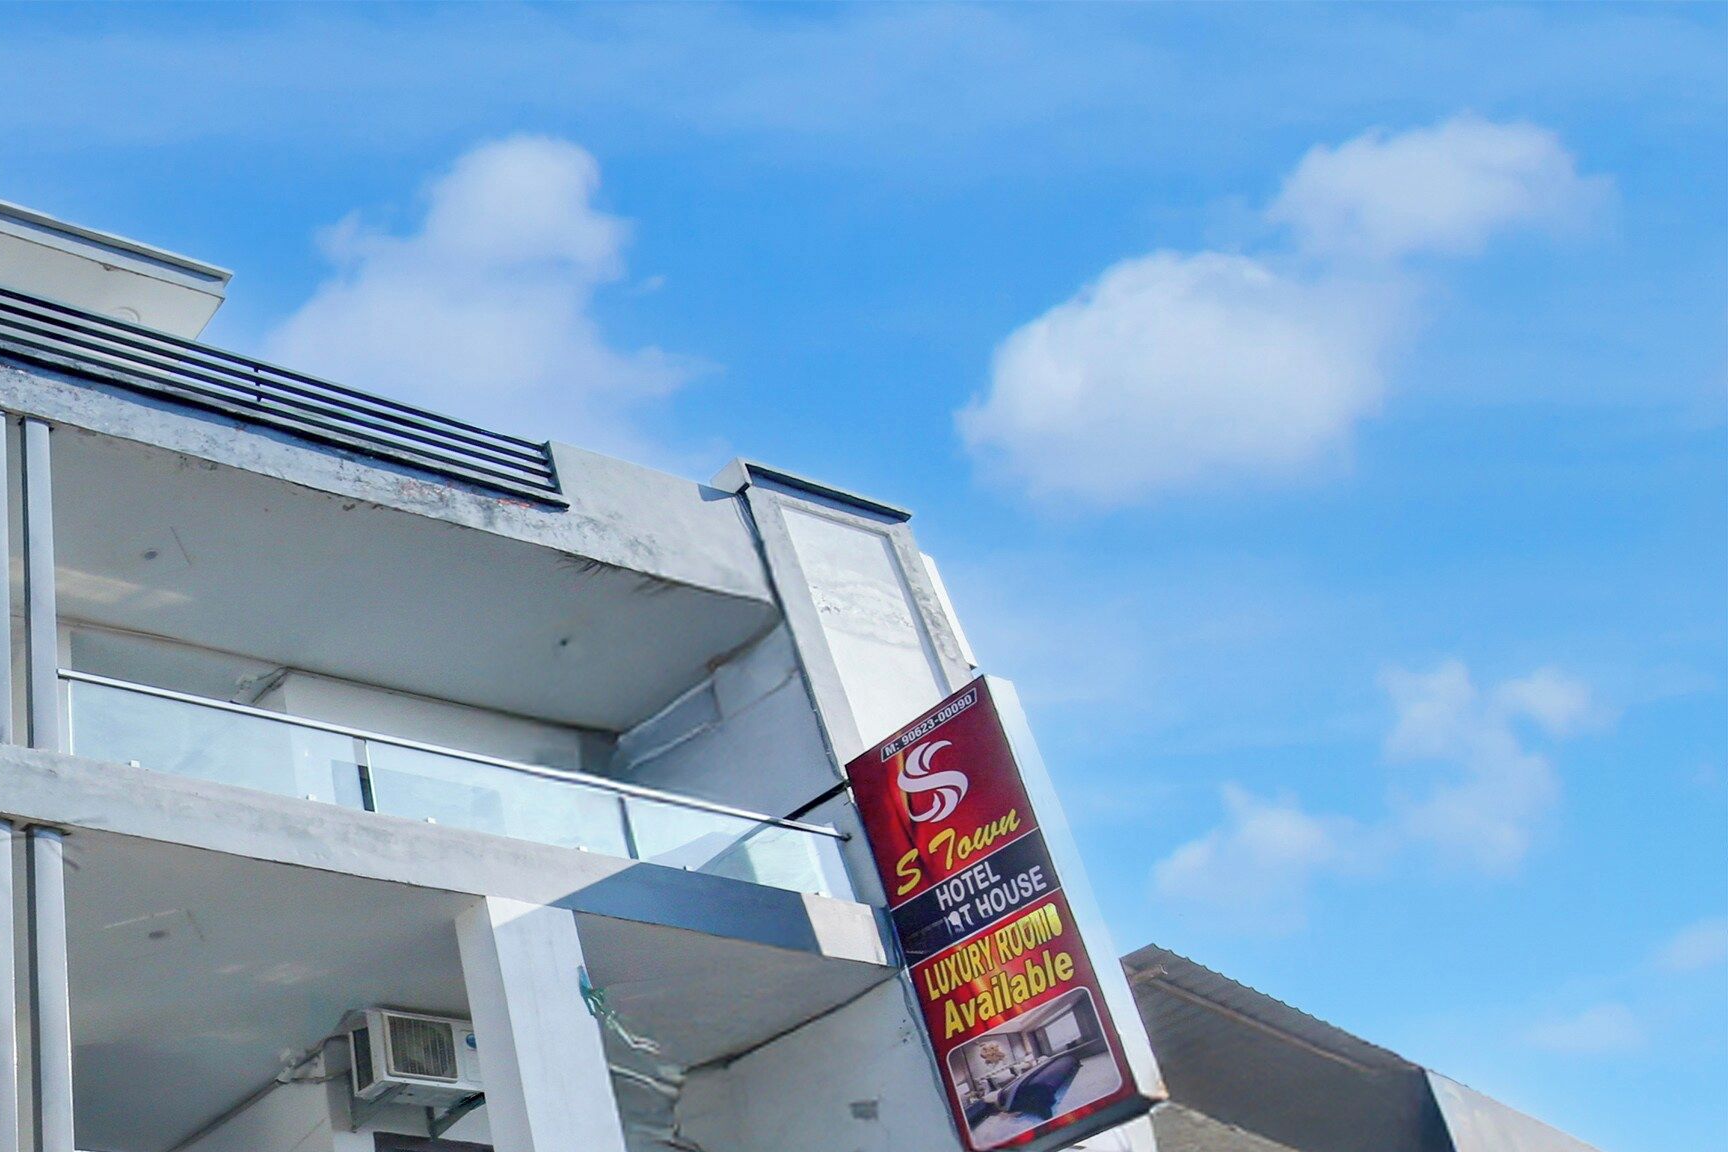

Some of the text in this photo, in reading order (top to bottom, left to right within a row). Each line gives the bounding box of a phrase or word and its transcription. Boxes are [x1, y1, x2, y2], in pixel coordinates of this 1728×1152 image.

[885, 695, 973, 756] M: 90623-00090
[896, 808, 1021, 896] S Town
[936, 861, 1001, 911] HOTEL
[975, 865, 1047, 918] HOUSE
[924, 935, 994, 1001] LUXURY
[945, 949, 1075, 1040] Available
